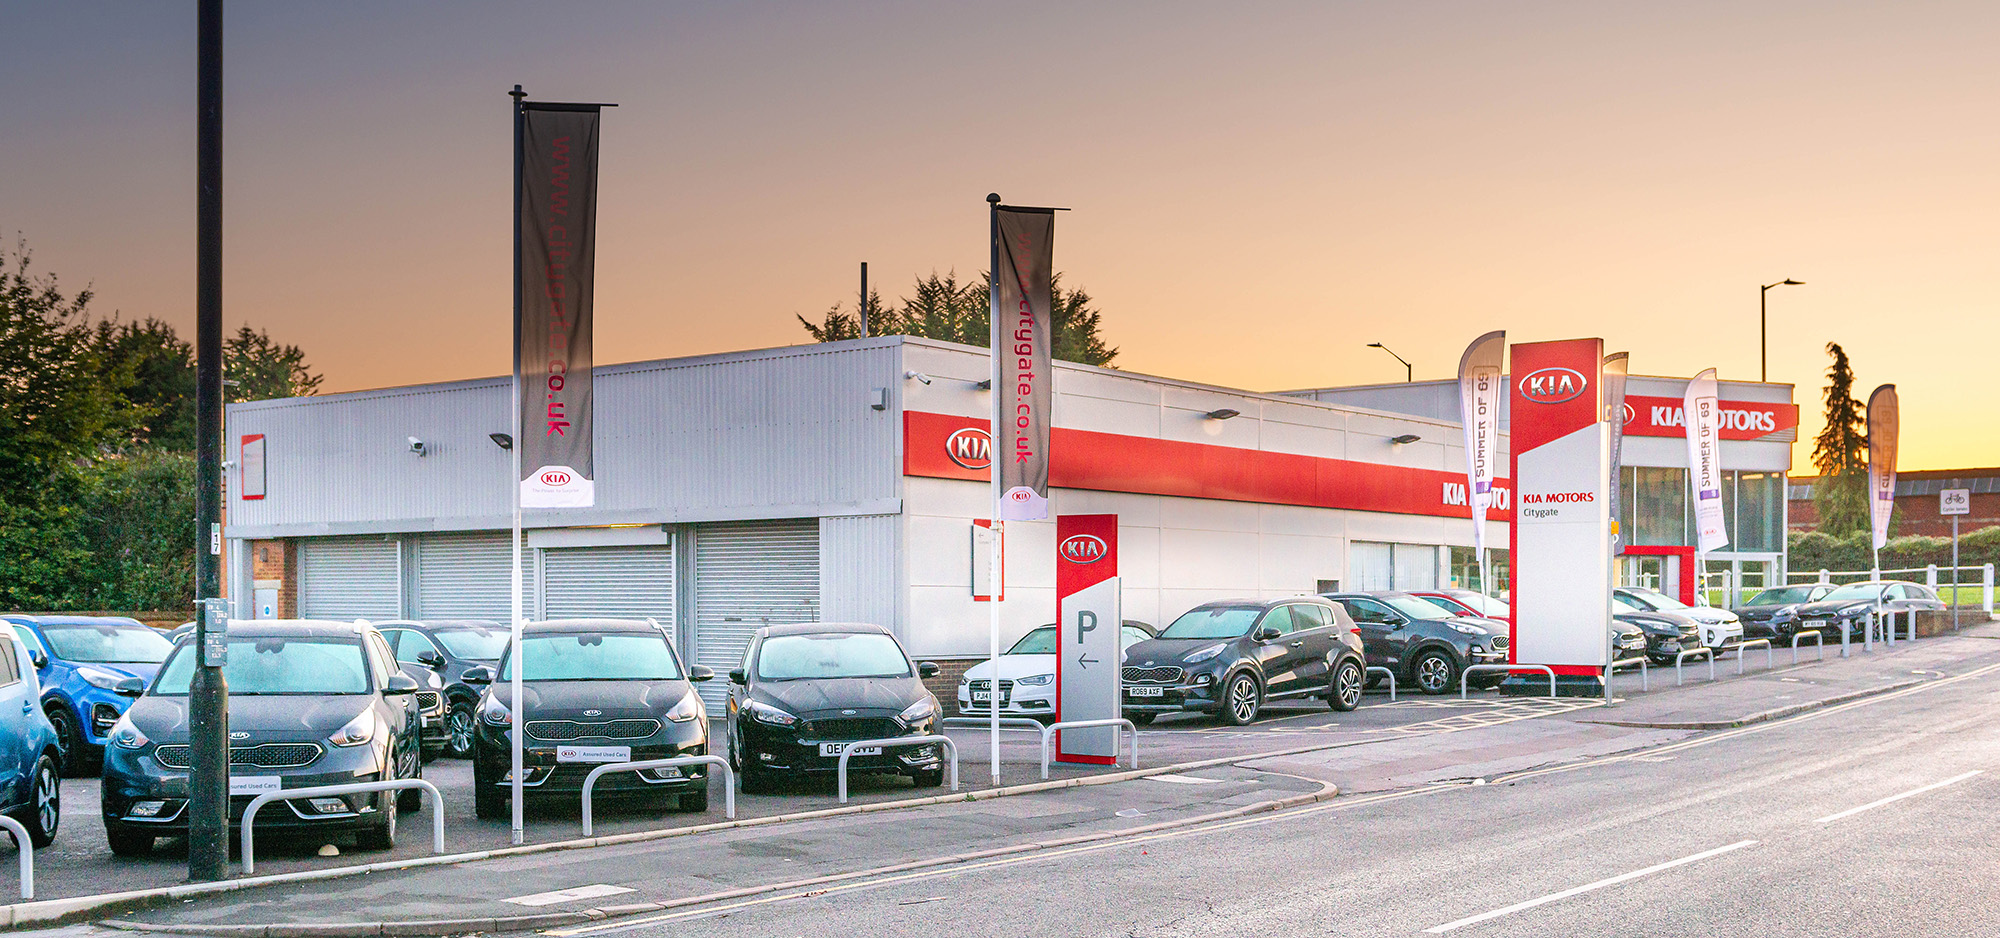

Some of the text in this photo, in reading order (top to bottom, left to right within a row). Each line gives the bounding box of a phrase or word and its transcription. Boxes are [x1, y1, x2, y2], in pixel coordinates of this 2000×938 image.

[545, 136, 572, 437] www.citygate.co.uk
[1014, 232, 1035, 464] www.citygate.co.uk
[1530, 375, 1575, 396] KIA
[1478, 397, 1487, 415] OF
[1651, 406, 1687, 427] KIA
[956, 436, 991, 460] KIA
[1476, 421, 1486, 478] SUMMER
[1700, 402, 1711, 487] SUMMER OF 69
[546, 474, 566, 482] KIA
[1442, 482, 1467, 506] KIA
[1523, 493, 1542, 504] KIA
[1546, 492, 1594, 503] MOTORS
[1523, 508, 1559, 518] Citygate
[1067, 541, 1099, 557] KIA
[1078, 610, 1098, 644] P
